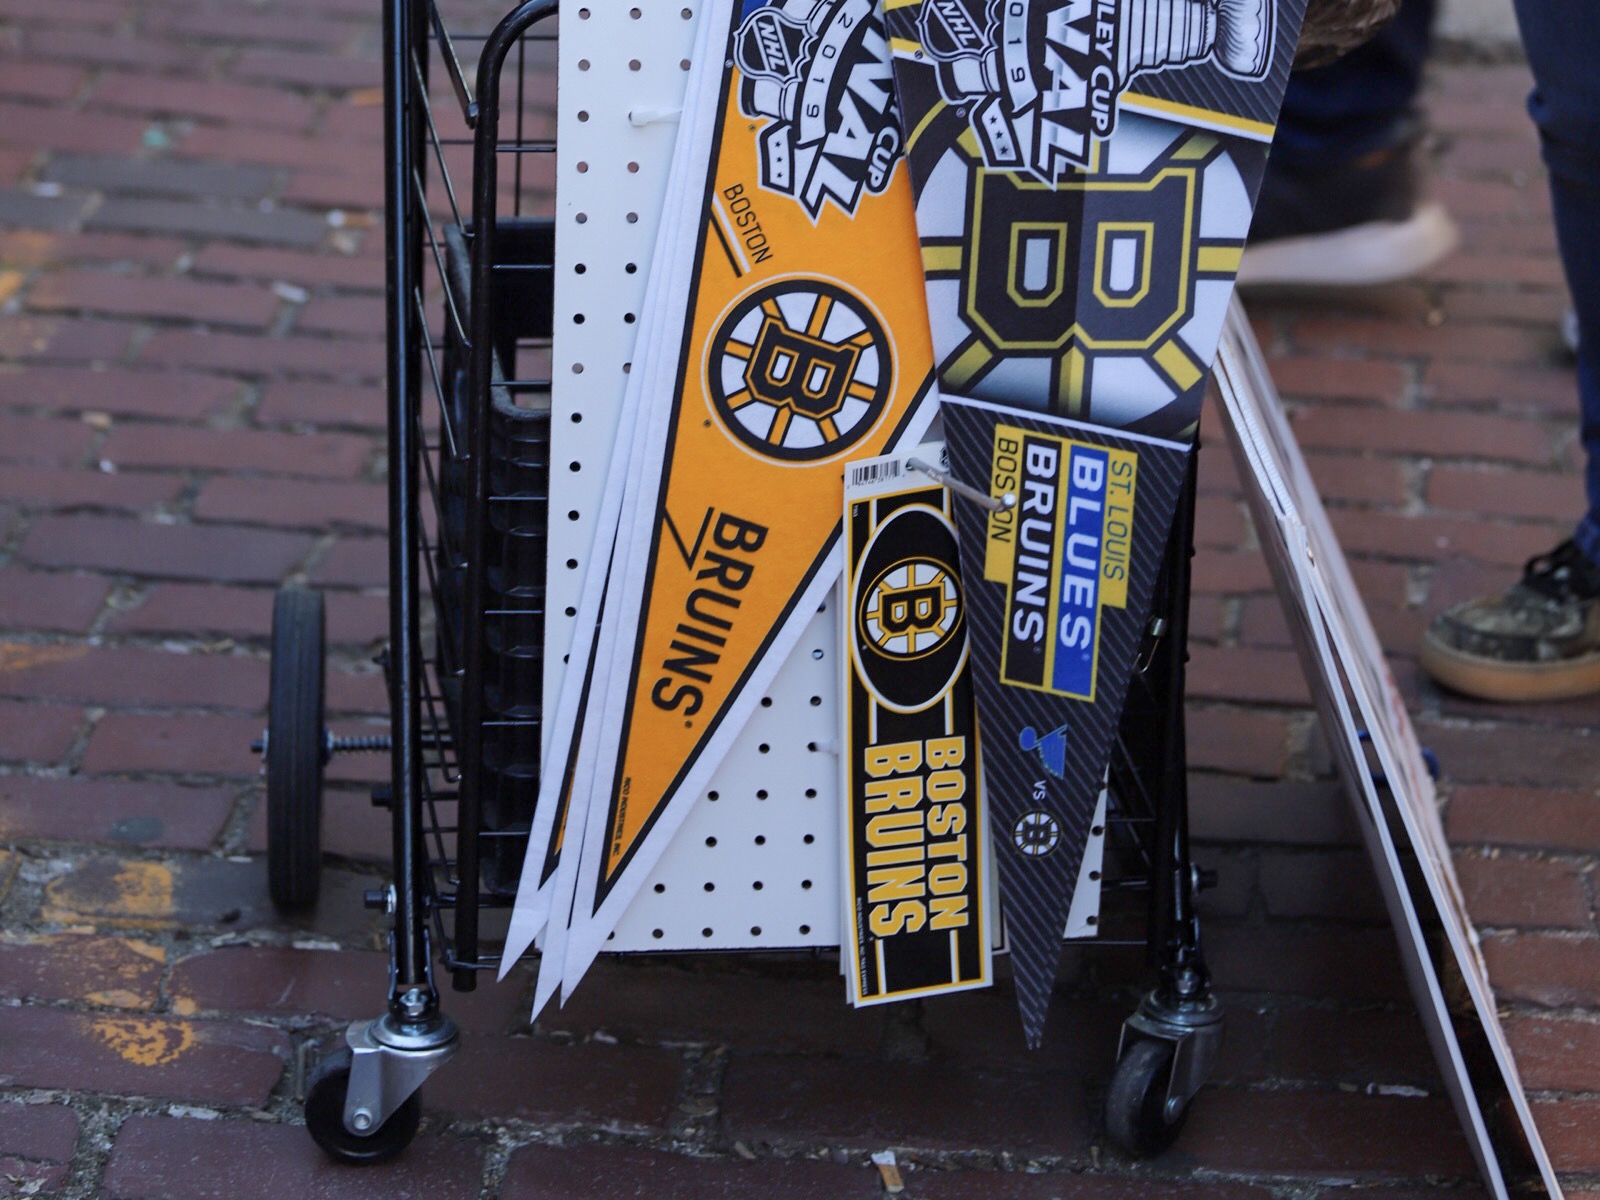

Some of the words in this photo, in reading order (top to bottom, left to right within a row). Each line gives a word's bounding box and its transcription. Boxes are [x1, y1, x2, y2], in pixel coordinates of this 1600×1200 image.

[757, 20, 781, 72] NHL
[805, 12, 854, 119] 2019
[937, 0, 974, 47] NHL
[1090, 70, 1115, 130] CUP
[867, 126, 899, 189] CUP
[724, 183, 774, 265] BOSTON
[990, 437, 1019, 544] BOSON
[1111, 461, 1133, 498] ST.
[1012, 444, 1059, 644] BRUINS
[1060, 453, 1106, 651] BLUES
[1102, 504, 1129, 581] LOUIS
[651, 511, 770, 718] BRUINS
[864, 740, 927, 940] BRUINS
[925, 735, 970, 931] BOSTON
